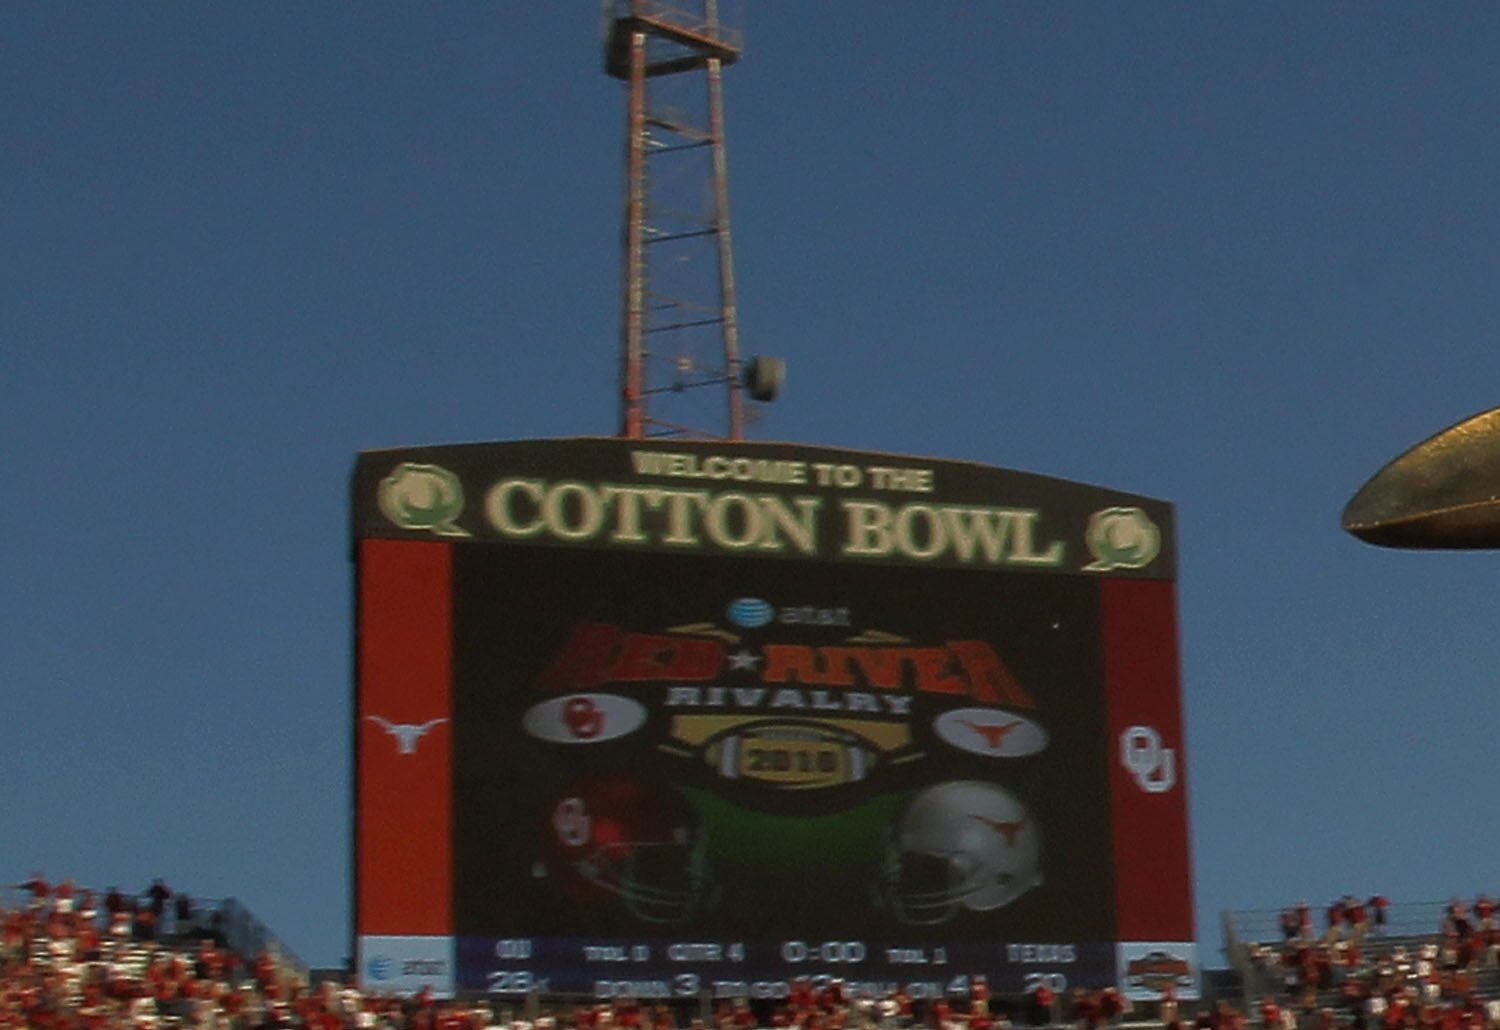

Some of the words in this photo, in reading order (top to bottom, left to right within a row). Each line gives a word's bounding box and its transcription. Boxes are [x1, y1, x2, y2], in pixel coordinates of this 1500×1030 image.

[631, 451, 807, 486] WELCOME
[811, 463, 863, 490] TO
[866, 466, 935, 493] THE
[485, 478, 822, 554] COTTON
[841, 501, 1064, 565] BOWL
[665, 687, 914, 714] RIVALRY
[781, 940, 867, 964] 0:00
[1004, 942, 1077, 963] TEXAS
[673, 972, 700, 996] 3
